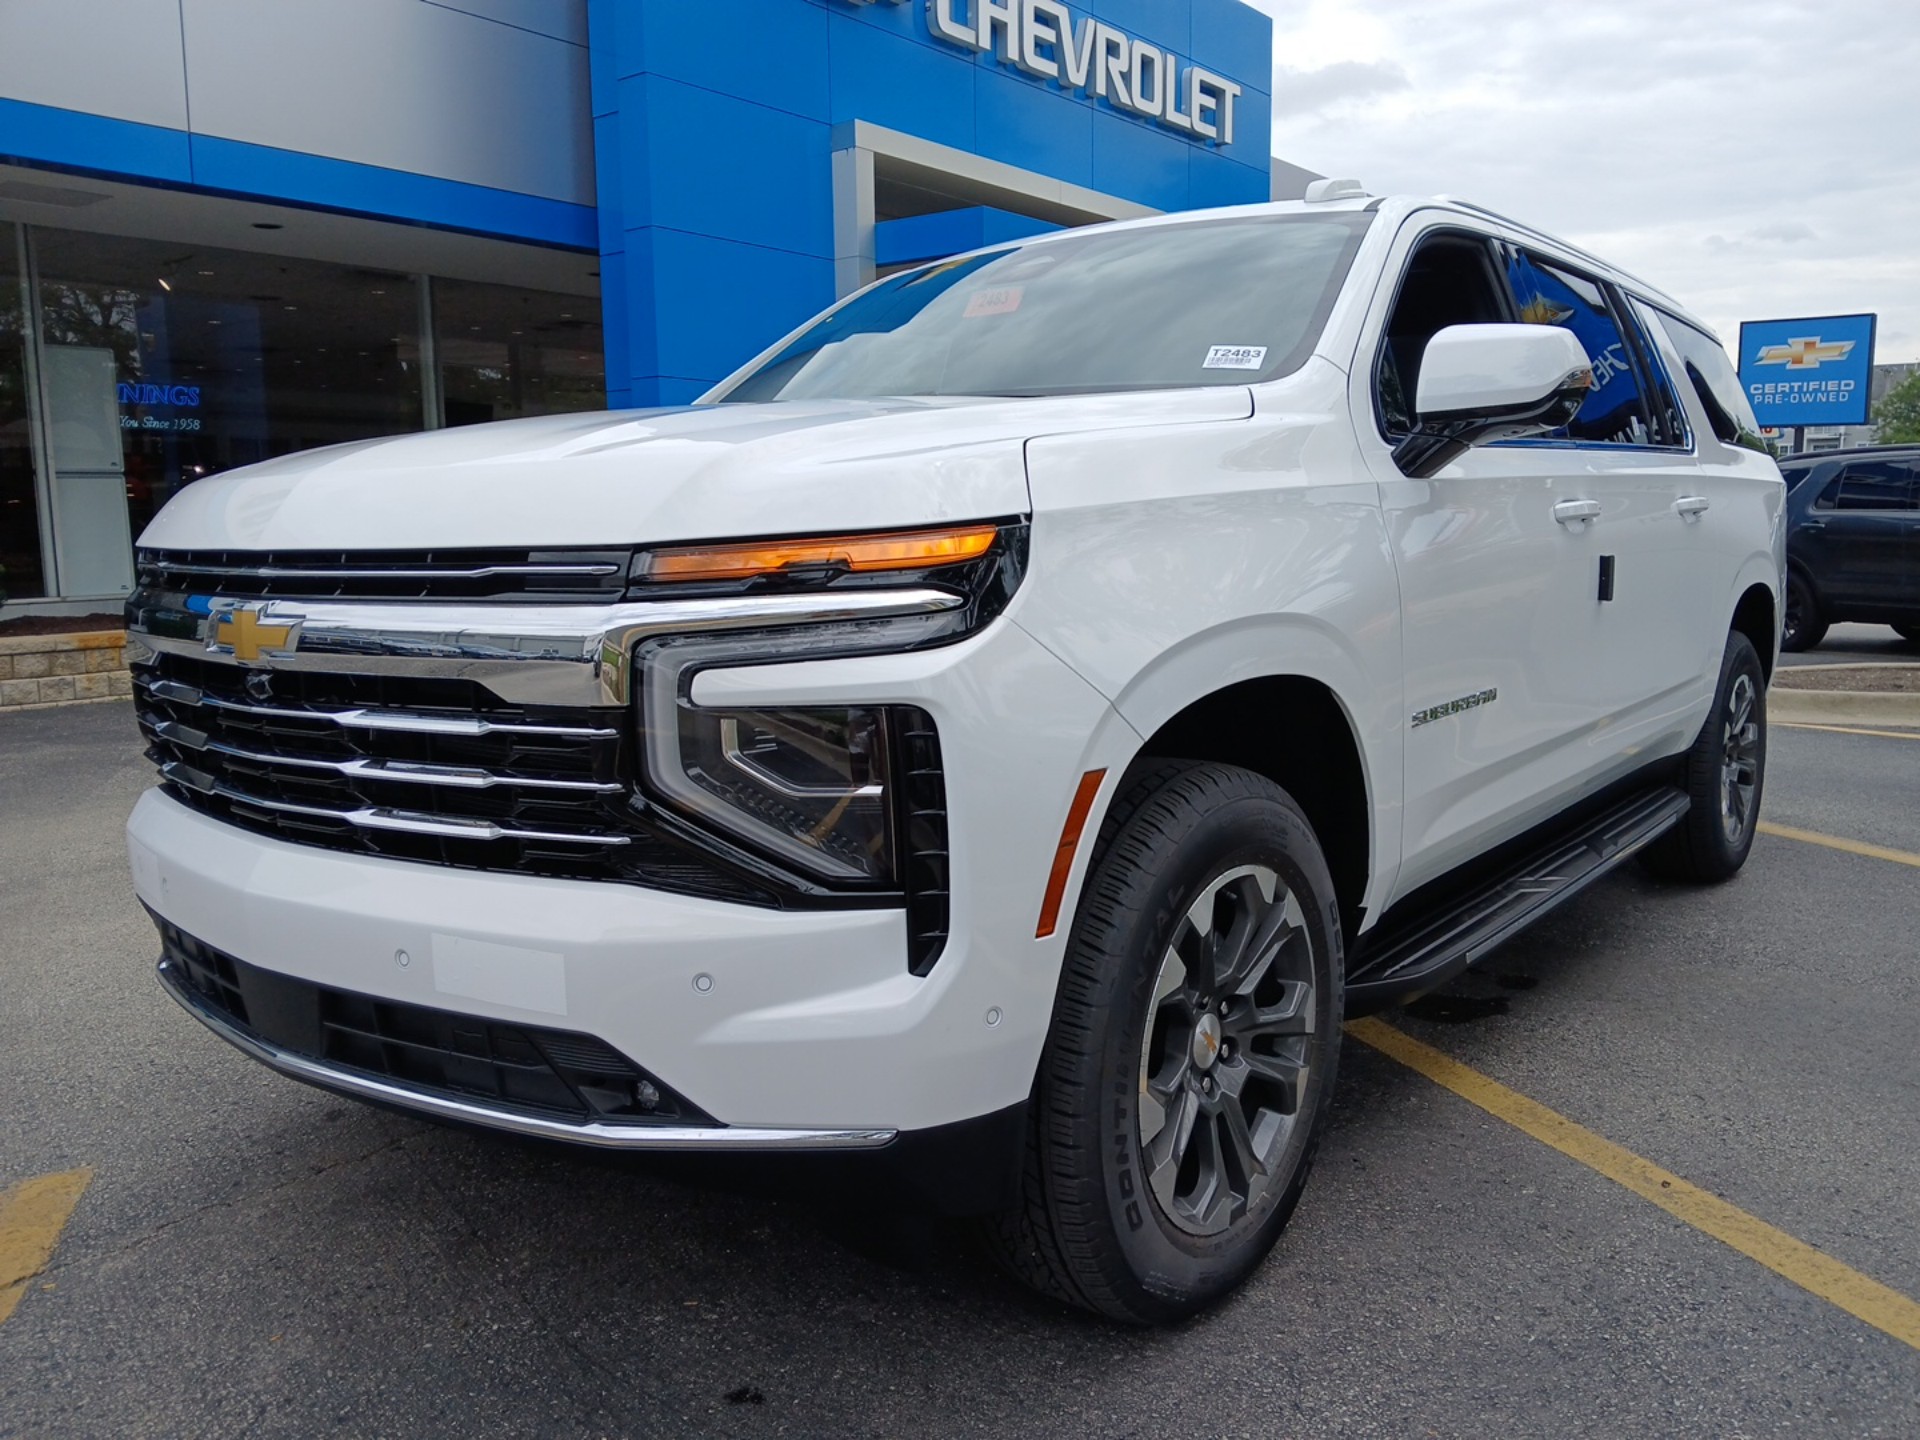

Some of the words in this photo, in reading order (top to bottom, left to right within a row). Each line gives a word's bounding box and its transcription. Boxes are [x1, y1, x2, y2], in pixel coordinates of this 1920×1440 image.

[926, 0, 1241, 146] CHEVROLET
[1212, 348, 1262, 358] T2483
[1750, 379, 1855, 394] CERTIFIED
[1754, 392, 1849, 405] PRE-OWNED
[120, 415, 139, 428] You
[142, 415, 170, 429] Since
[173, 418, 201, 431] 1958
[1411, 687, 1498, 729] SUBURBAN
[1112, 883, 1185, 1233] CONTINTAL
